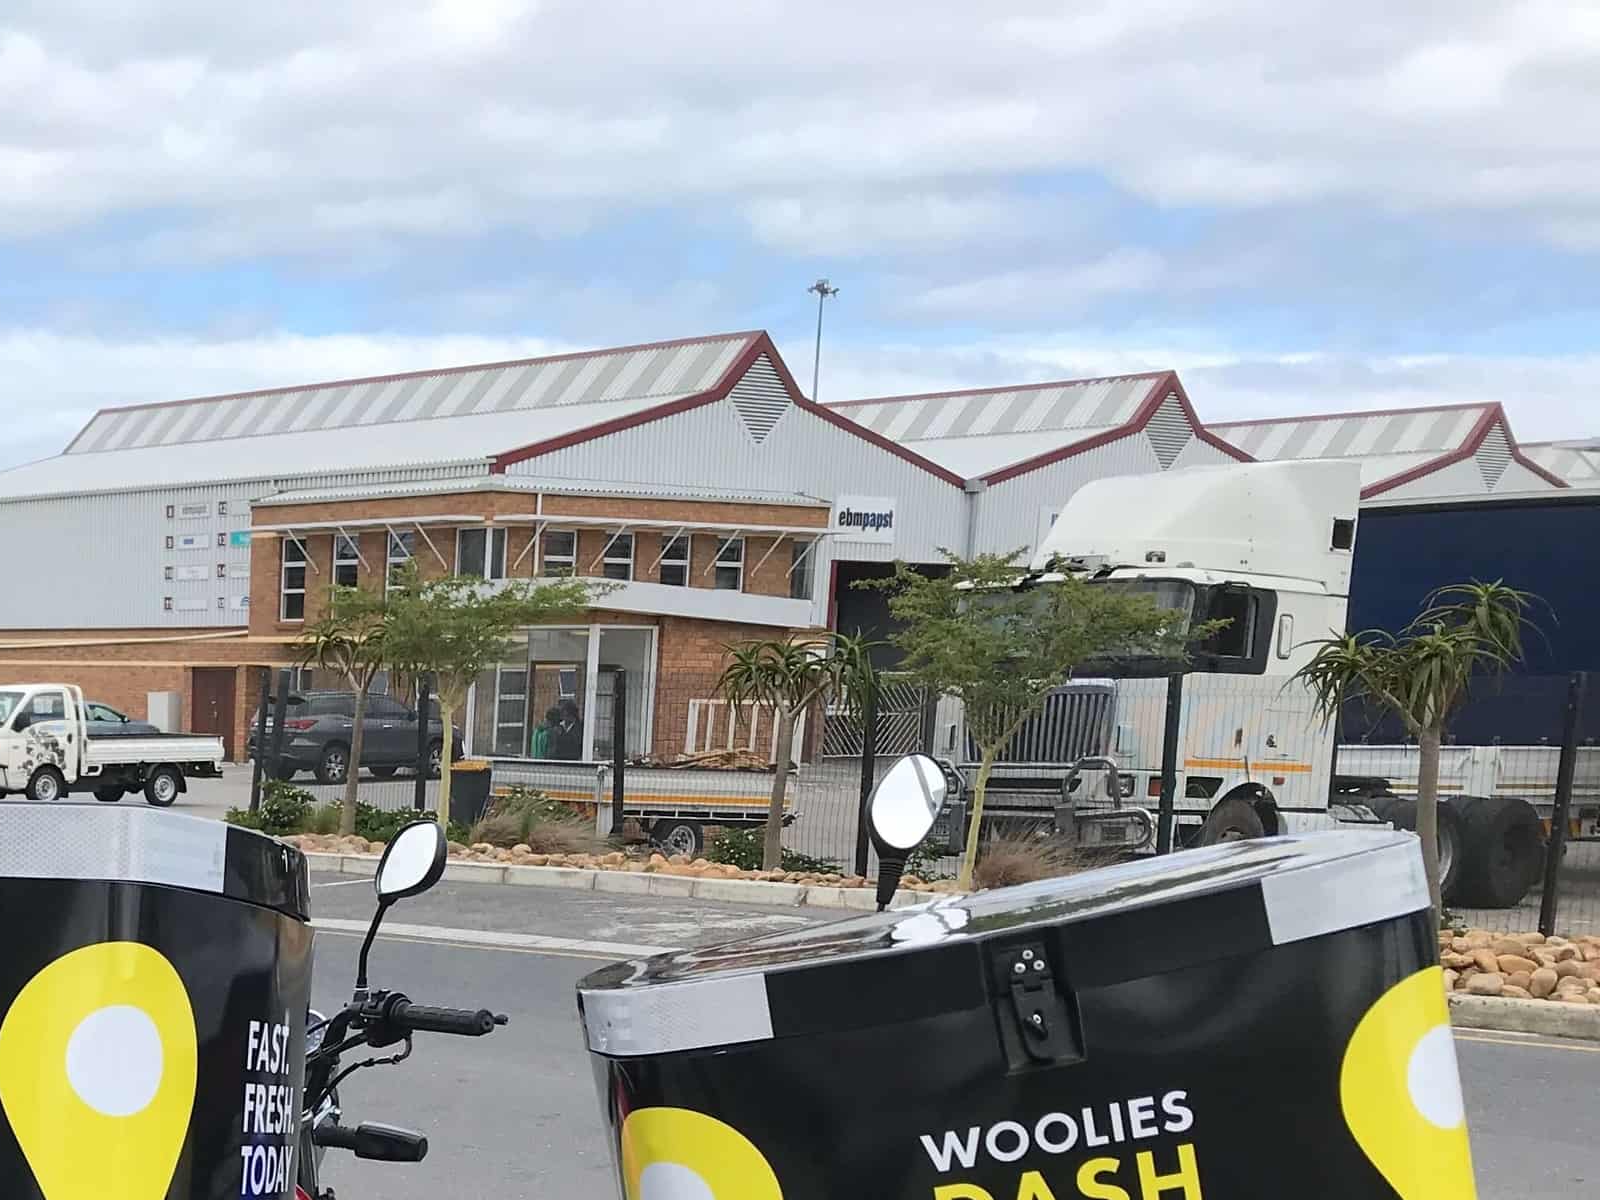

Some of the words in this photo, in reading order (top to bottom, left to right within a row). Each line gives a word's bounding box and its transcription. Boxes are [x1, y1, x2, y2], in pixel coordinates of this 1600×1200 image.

[838, 507, 893, 532] ebmpapst
[246, 1020, 290, 1075] FAST.
[243, 1083, 294, 1136] FRESH.
[919, 1090, 1194, 1172] WOOLIES
[241, 1145, 294, 1195] TODAY
